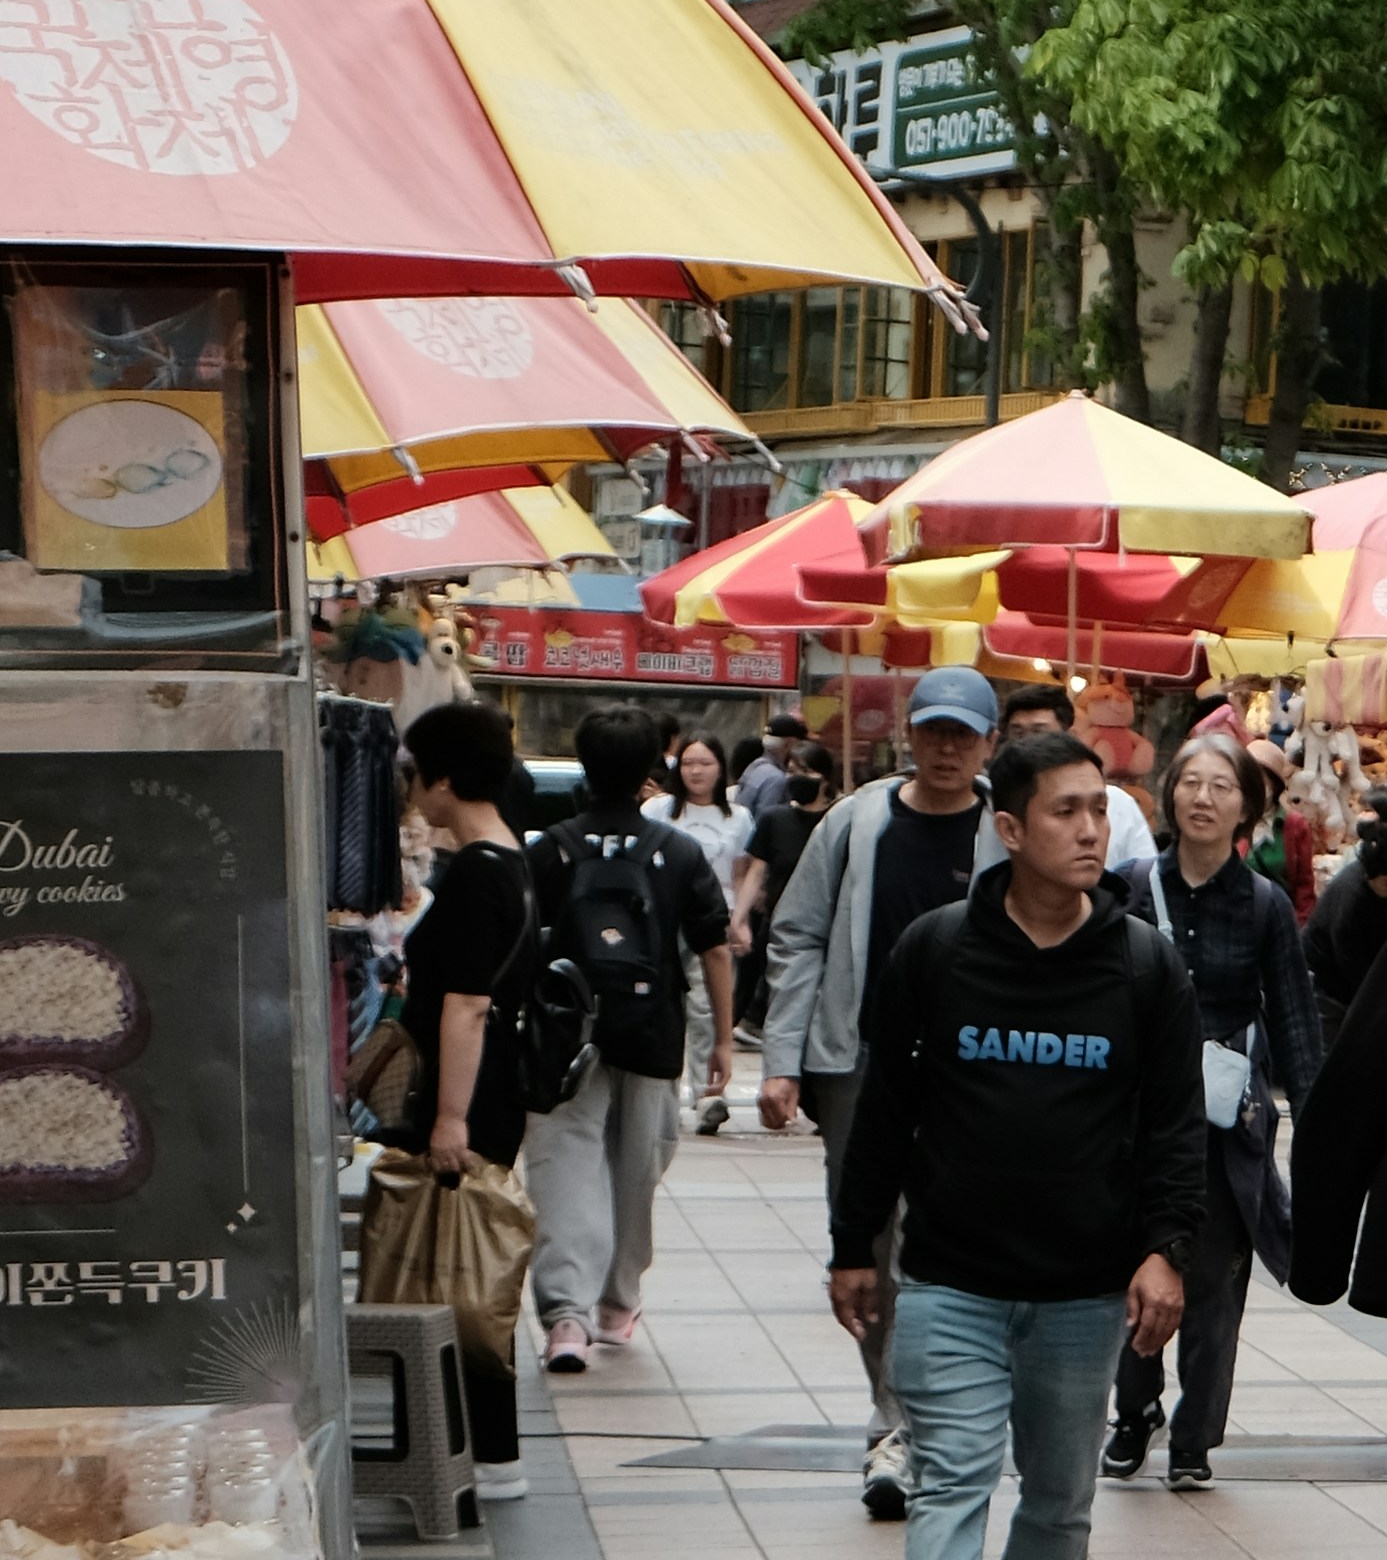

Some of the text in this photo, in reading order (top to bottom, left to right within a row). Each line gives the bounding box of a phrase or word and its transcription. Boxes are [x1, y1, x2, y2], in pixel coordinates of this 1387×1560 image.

[0, 819, 114, 873] Dubai
[37, 875, 126, 903] cookies
[958, 1025, 1113, 1070] SANDER
